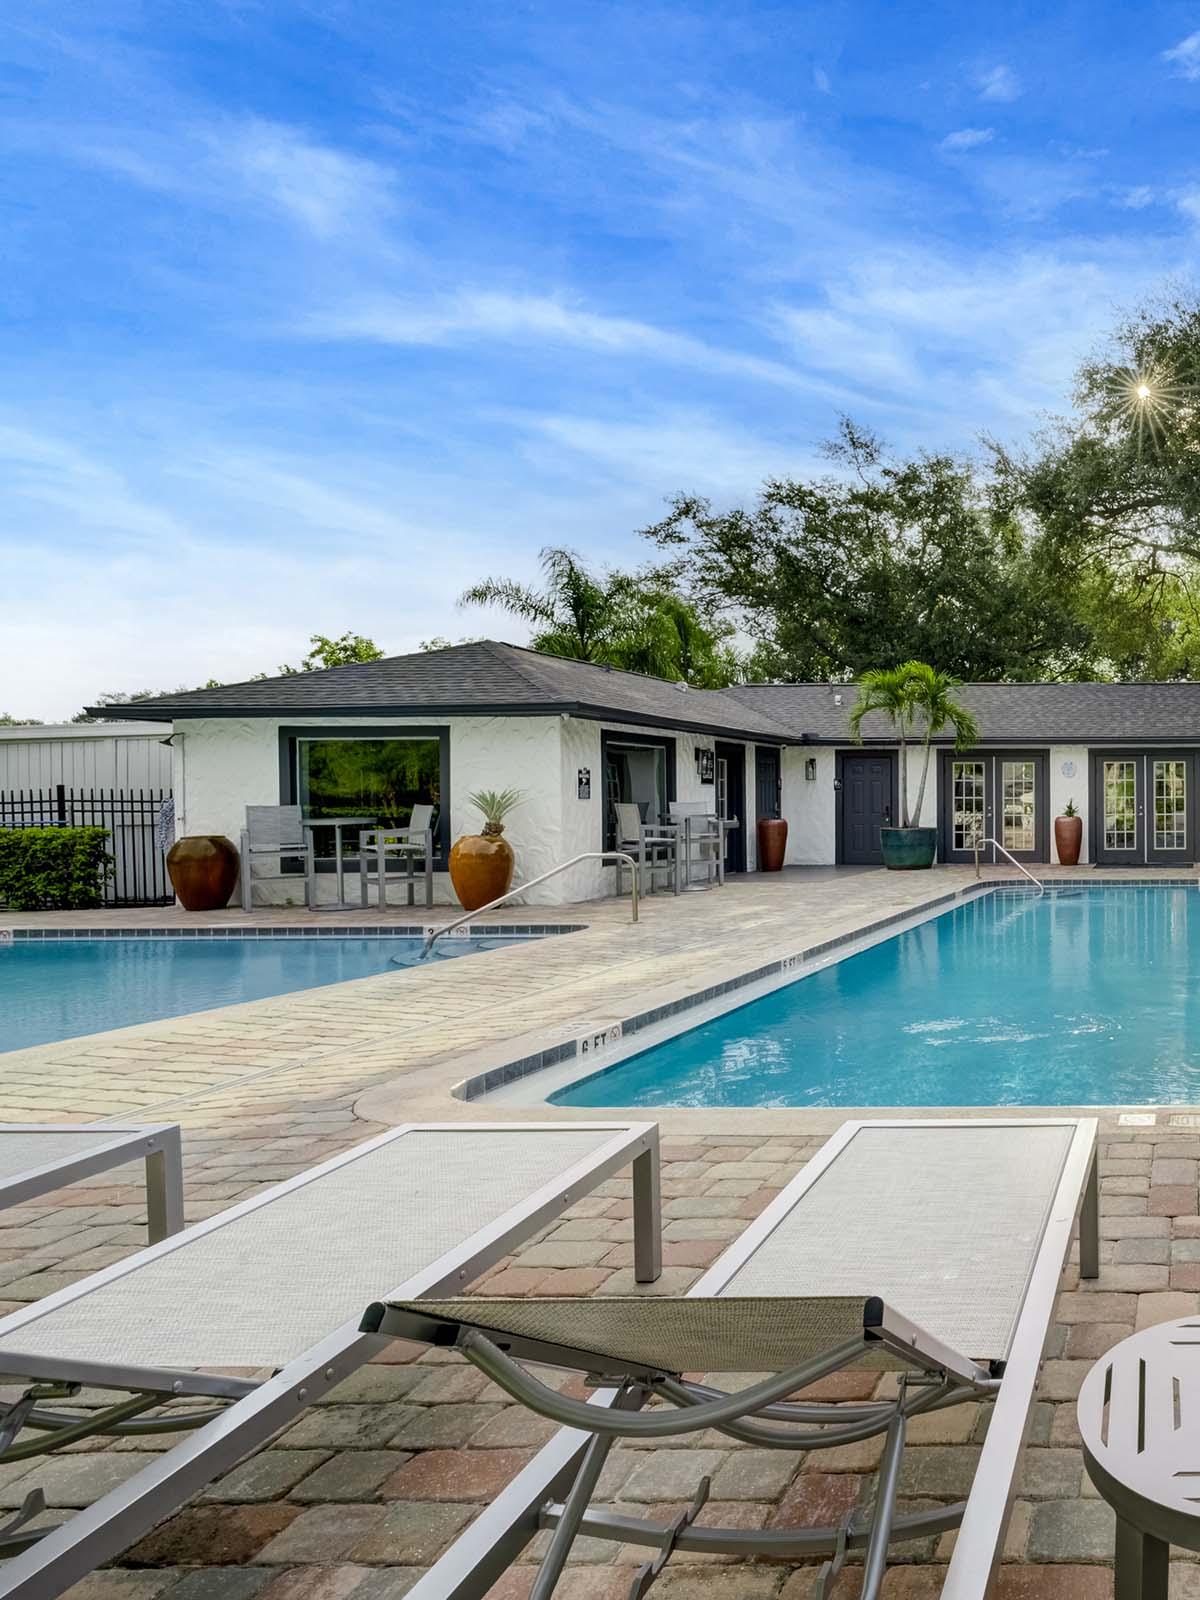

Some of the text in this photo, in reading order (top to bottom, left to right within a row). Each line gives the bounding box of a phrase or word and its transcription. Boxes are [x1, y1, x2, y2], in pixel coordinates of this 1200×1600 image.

[582, 1032, 607, 1054] 6 FT
[1171, 1115, 1190, 1126] NO
